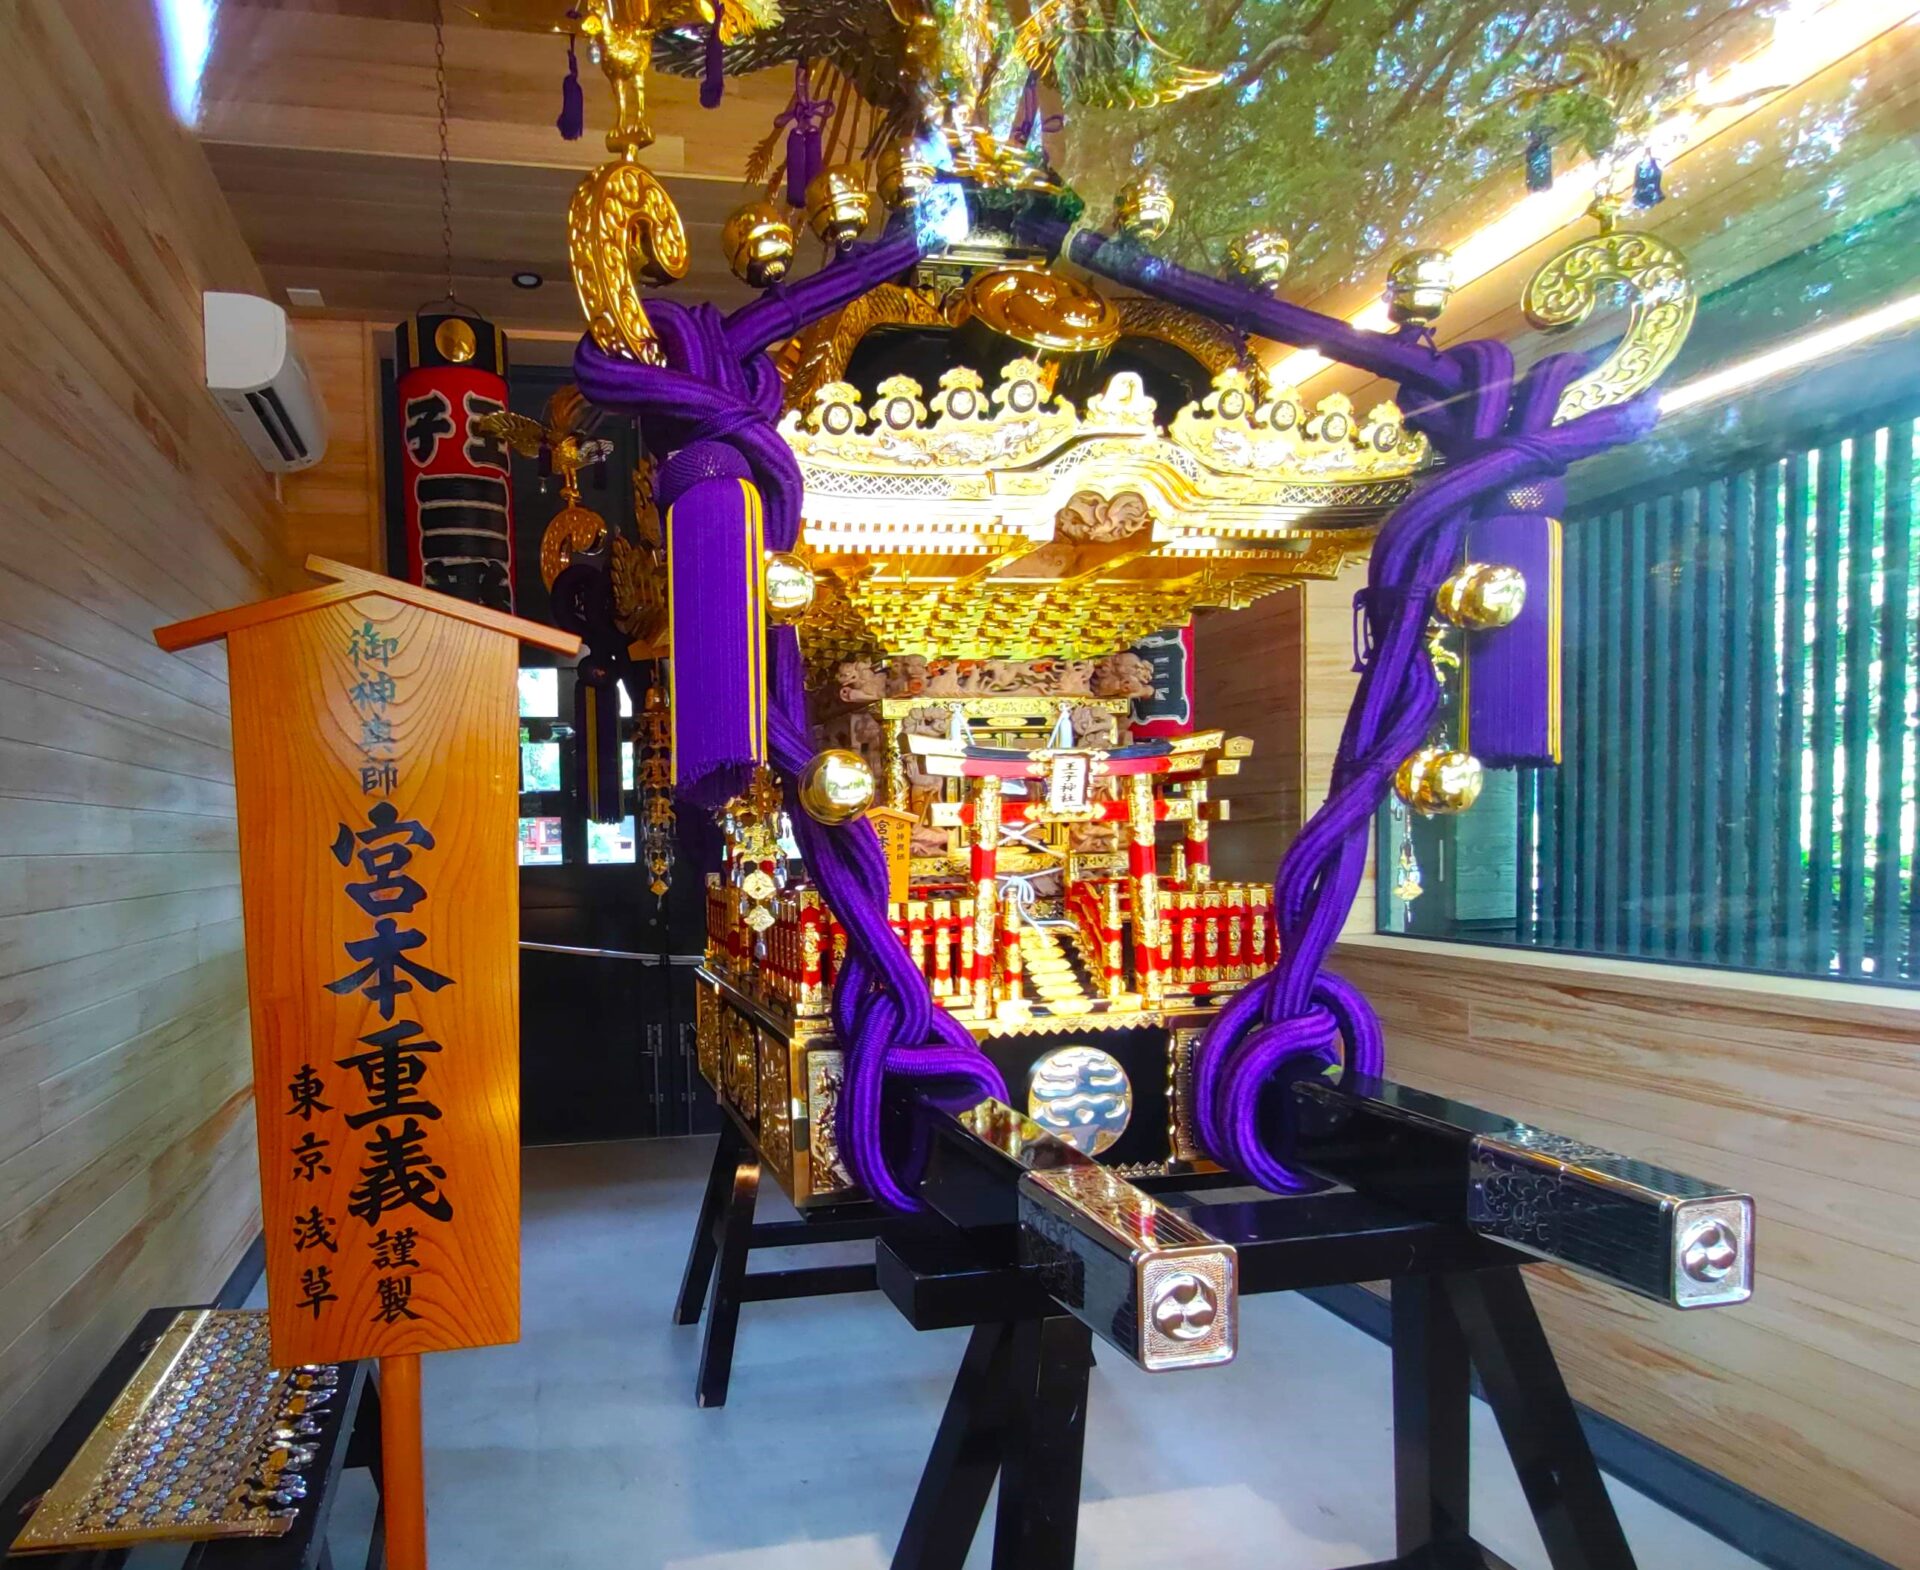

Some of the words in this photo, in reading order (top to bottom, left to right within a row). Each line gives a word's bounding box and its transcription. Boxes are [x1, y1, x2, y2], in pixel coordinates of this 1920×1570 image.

[1060, 761, 1079, 803] 王子神社
[324, 802, 454, 1227] 宮本重義
[286, 1063, 339, 1320] 東京浅草
[369, 1227, 422, 1325] 謹製
